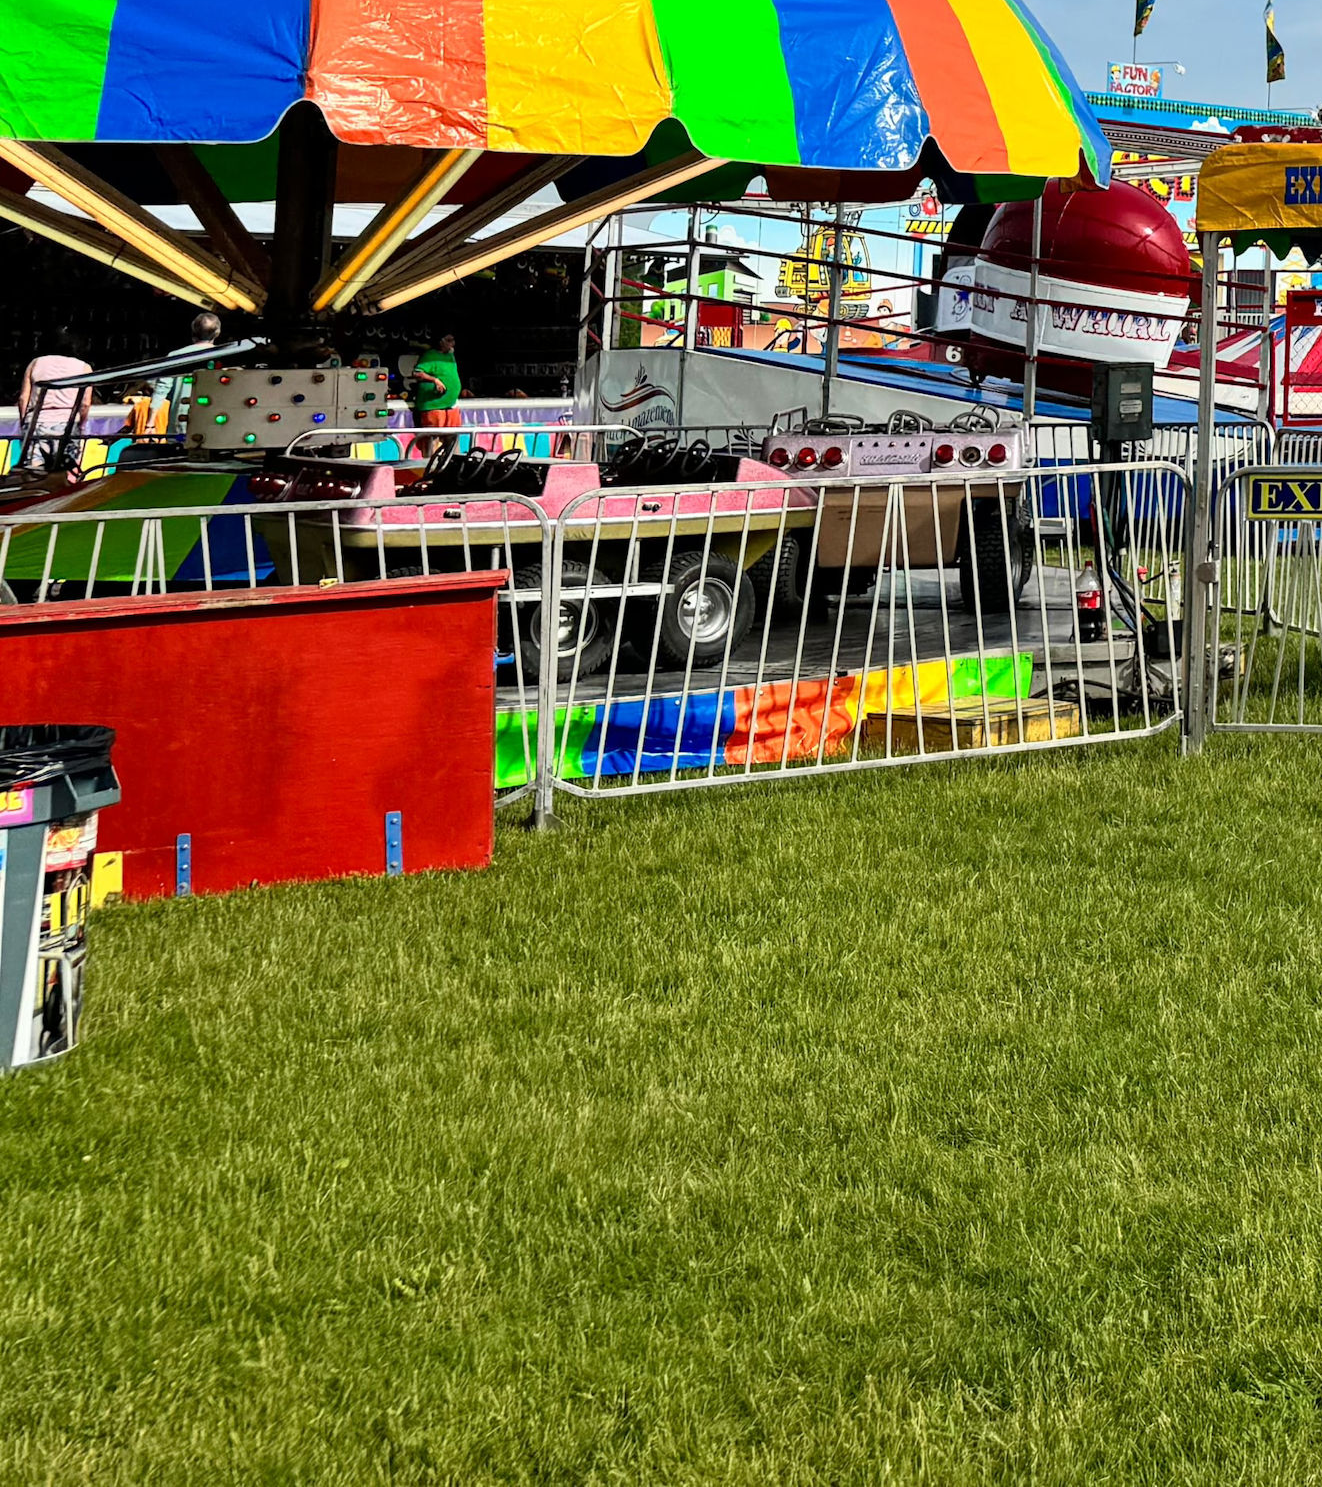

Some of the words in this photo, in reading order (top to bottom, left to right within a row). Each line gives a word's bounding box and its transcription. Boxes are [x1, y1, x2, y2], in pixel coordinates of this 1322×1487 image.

[1123, 65, 1148, 82] FUN
[1110, 82, 1168, 96] FACTORY
[1050, 306, 1171, 342] WHIRL
[945, 345, 962, 363] 6
